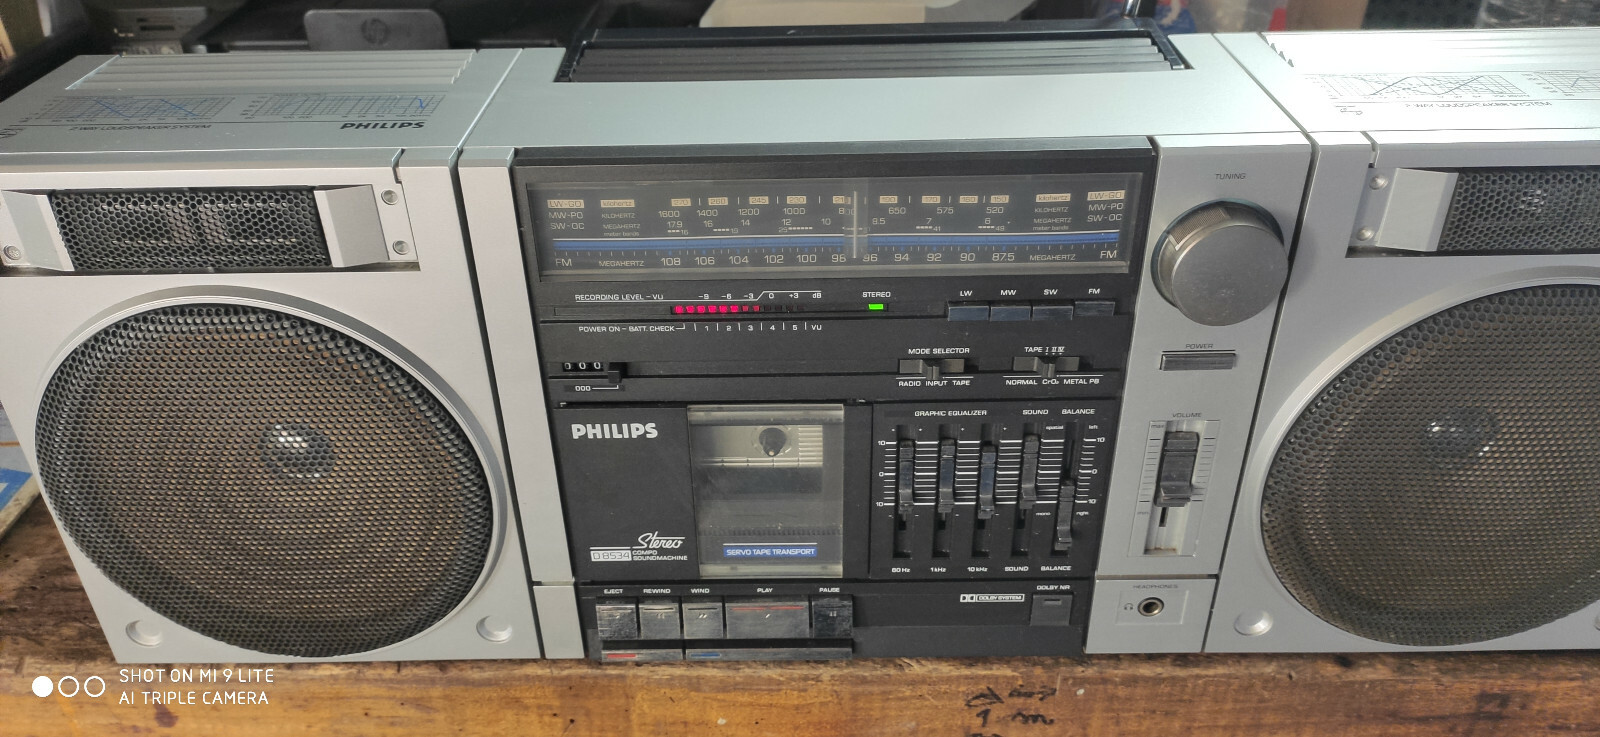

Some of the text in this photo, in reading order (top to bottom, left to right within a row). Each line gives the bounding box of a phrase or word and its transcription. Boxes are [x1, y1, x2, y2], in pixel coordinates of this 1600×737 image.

[340, 122, 425, 130] PHILIPS
[548, 211, 583, 219] MW-PO
[696, 209, 719, 217] 1400
[738, 208, 760, 216] 1200
[783, 207, 805, 215] 1000
[888, 207, 906, 215] 650
[936, 206, 954, 214] 575
[986, 206, 1004, 214] 520
[1088, 202, 1124, 211] MW-PO
[550, 222, 585, 230] SW-OC
[703, 220, 713, 228] 16
[781, 218, 792, 226] 12
[820, 217, 832, 226] 10
[926, 217, 933, 225] 7
[1087, 213, 1123, 223] SW-OC
[555, 258, 572, 267] FM
[660, 257, 681, 266] 108
[694, 256, 715, 266] 106
[729, 255, 749, 265] 104
[763, 254, 784, 264] 102
[796, 253, 817, 263] 100
[894, 253, 910, 262] 94
[926, 253, 942, 262] 92
[959, 252, 976, 262] 90
[991, 252, 1015, 262] 87.5
[1029, 253, 1076, 261] MEGAHERTZ
[1100, 250, 1118, 259] FM
[960, 289, 972, 297] LW
[1001, 289, 1017, 297] MW
[1044, 288, 1058, 296] SW
[571, 422, 658, 440] PHILIPS
[631, 531, 685, 549] Stereo
[602, 551, 630, 559] 8534
